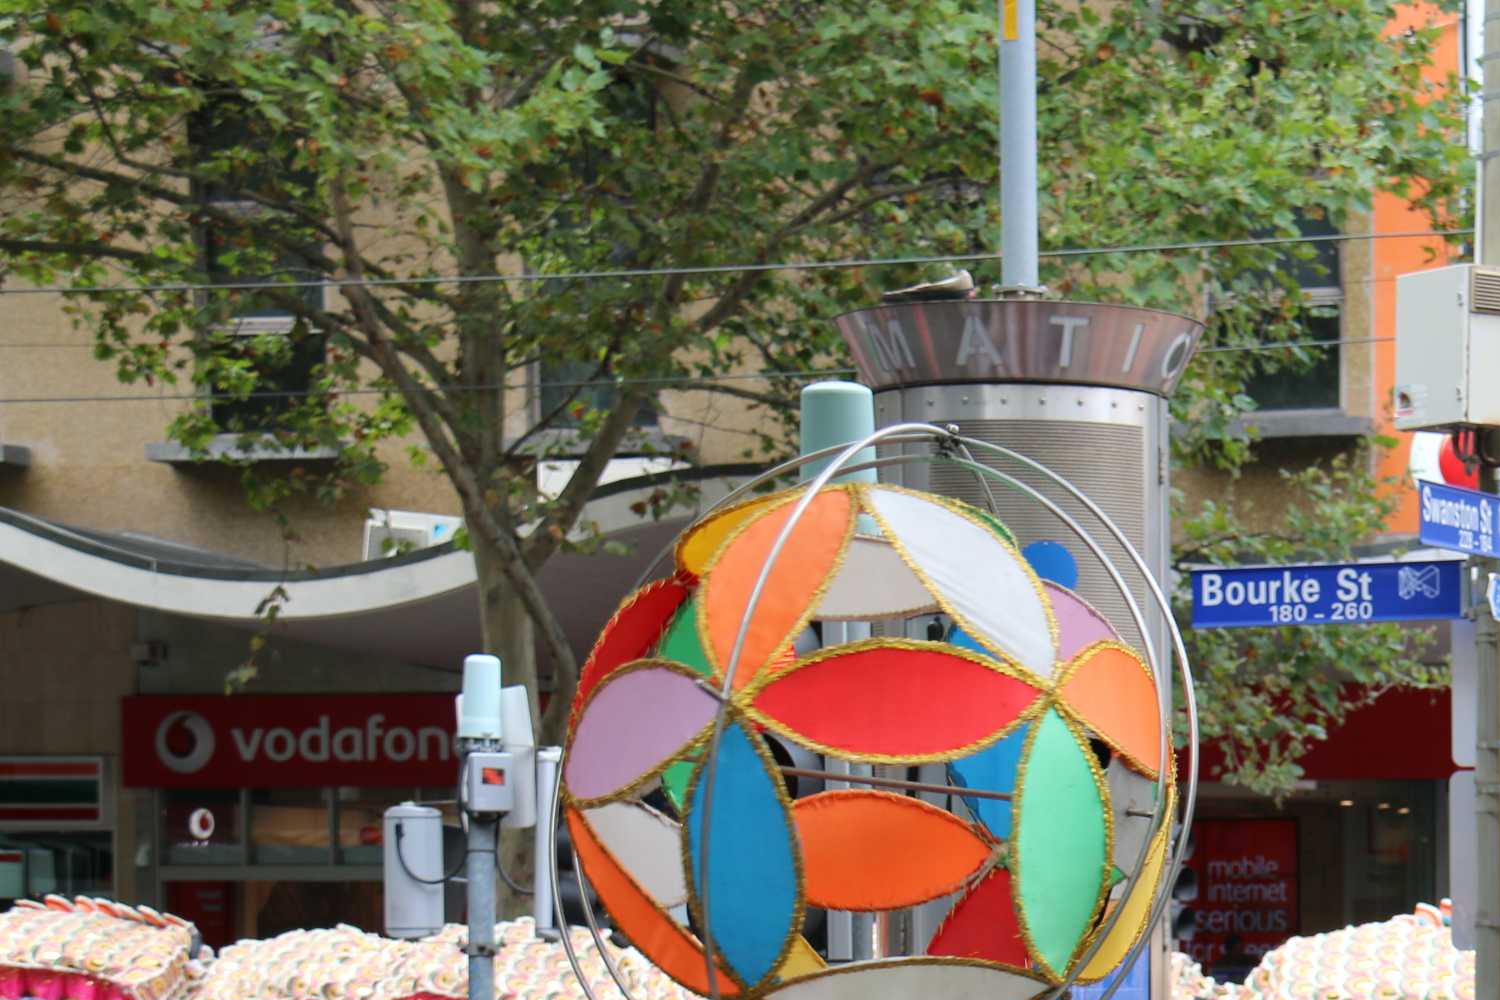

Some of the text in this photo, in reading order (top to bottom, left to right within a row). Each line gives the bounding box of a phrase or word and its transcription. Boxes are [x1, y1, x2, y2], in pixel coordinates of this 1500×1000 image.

[1422, 486, 1493, 534] Swanston St
[1201, 568, 1373, 606] Bourke St
[1268, 605, 1307, 623] 180
[1331, 602, 1373, 620] 260
[230, 713, 461, 763] vodafon
[1207, 855, 1279, 878] mobile
[1208, 882, 1287, 902] internet
[1196, 905, 1287, 932] serious
